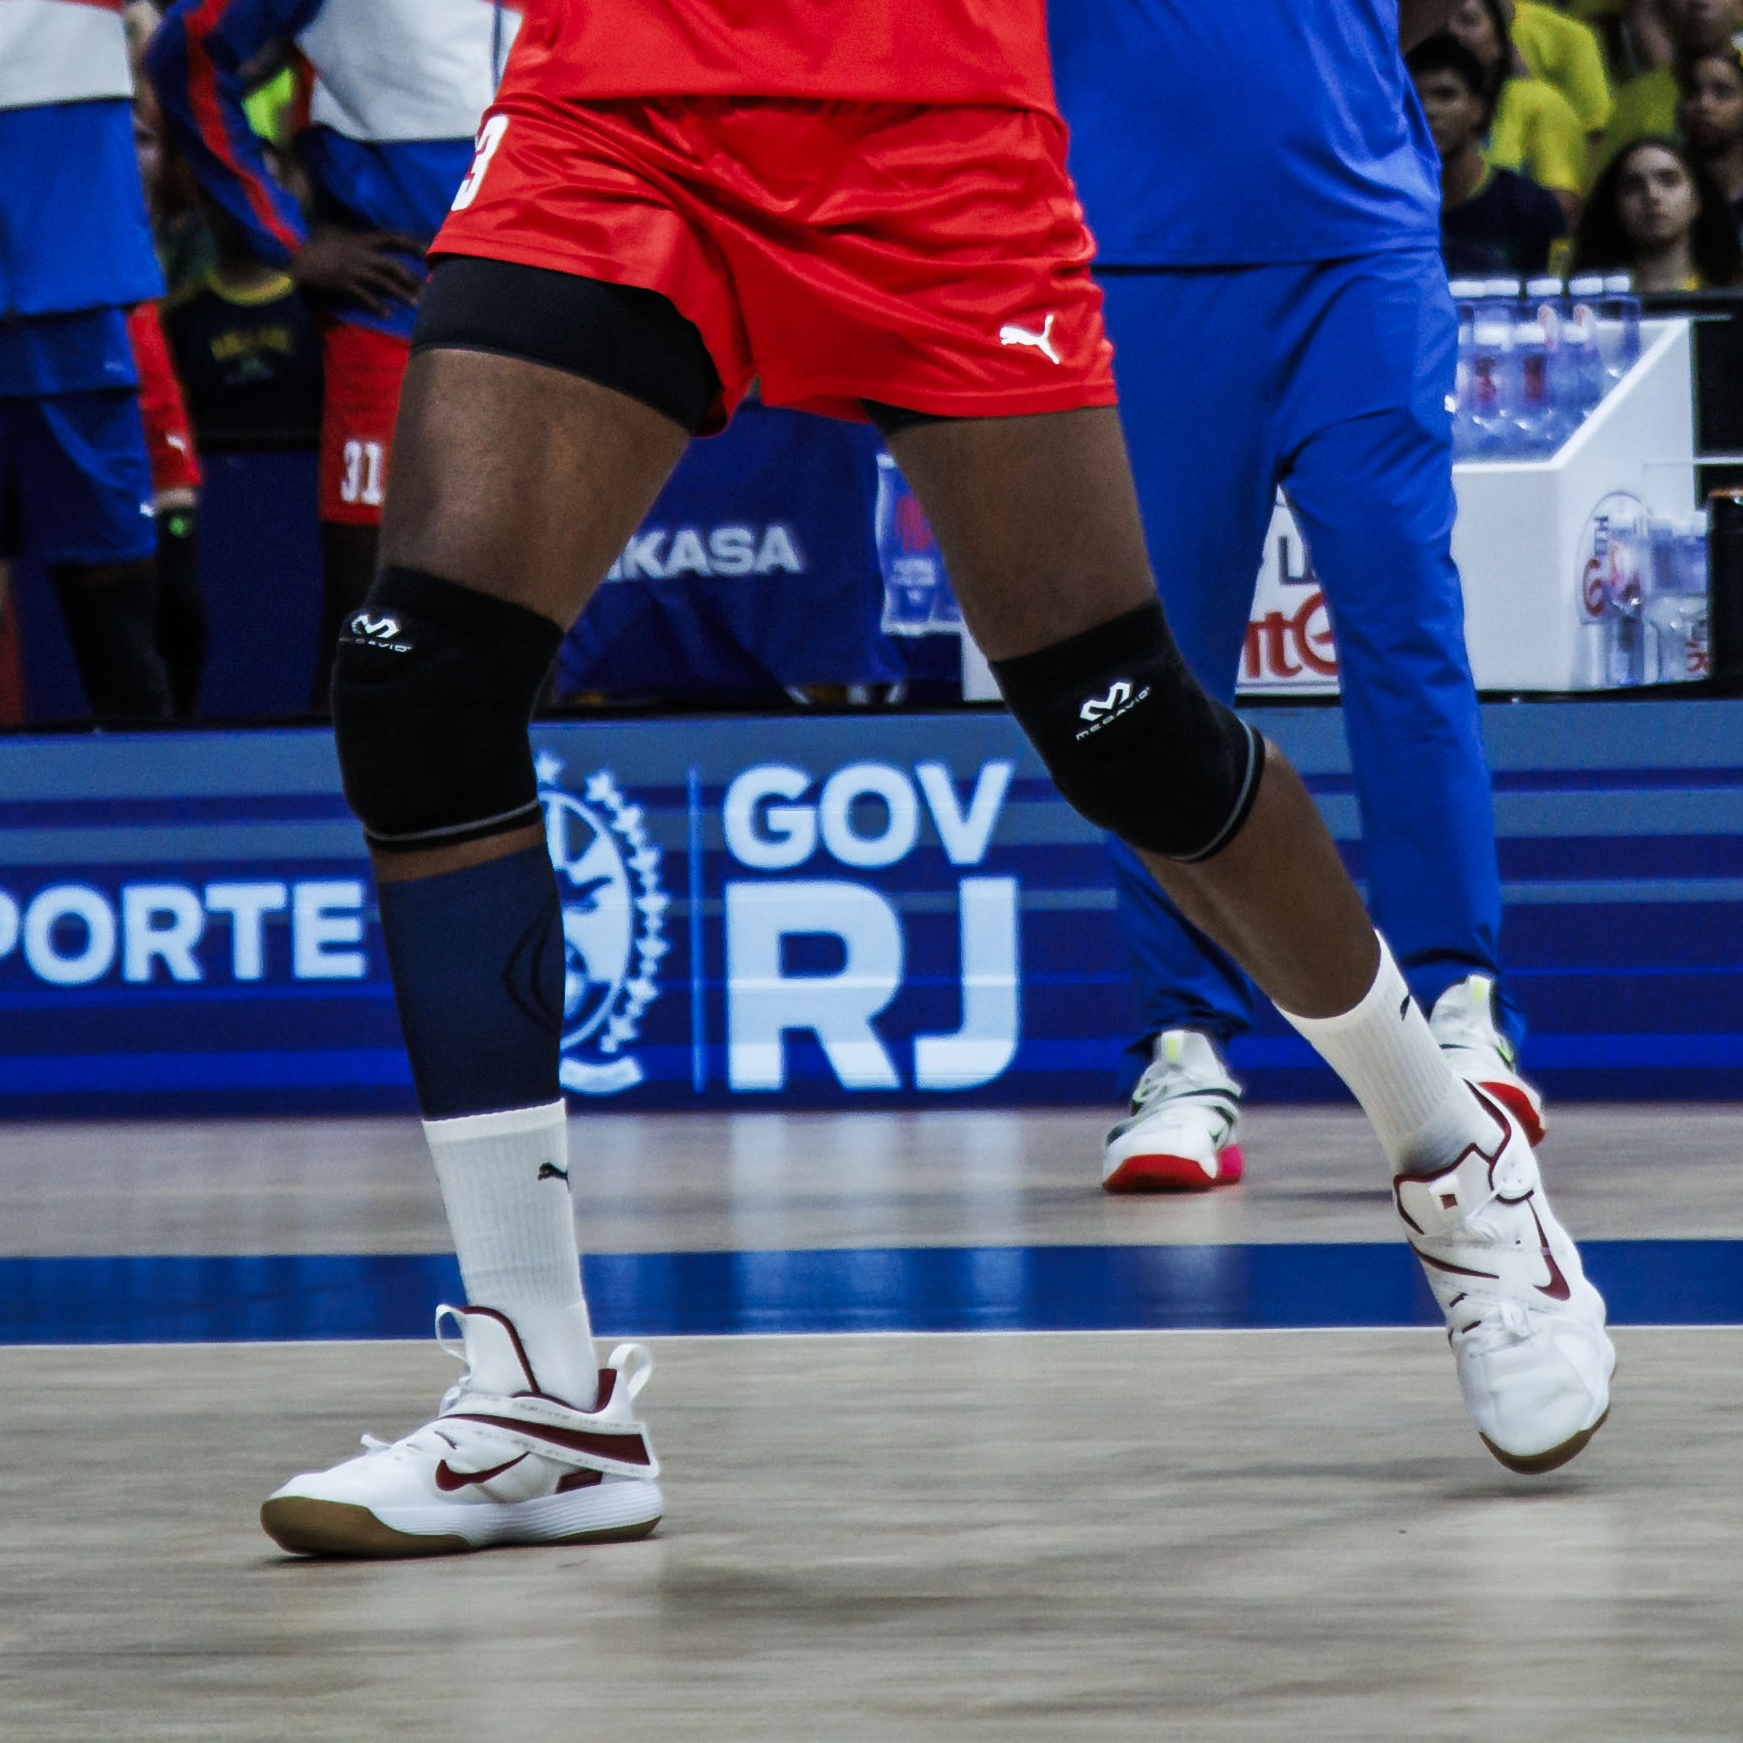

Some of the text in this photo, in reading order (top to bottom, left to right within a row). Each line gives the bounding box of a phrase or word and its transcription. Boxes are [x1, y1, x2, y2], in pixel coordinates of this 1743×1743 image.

[340, 440, 383, 506] 31
[606, 523, 804, 581] KASA
[722, 760, 1015, 869] GOV
[723, 875, 1021, 1092] RJ
